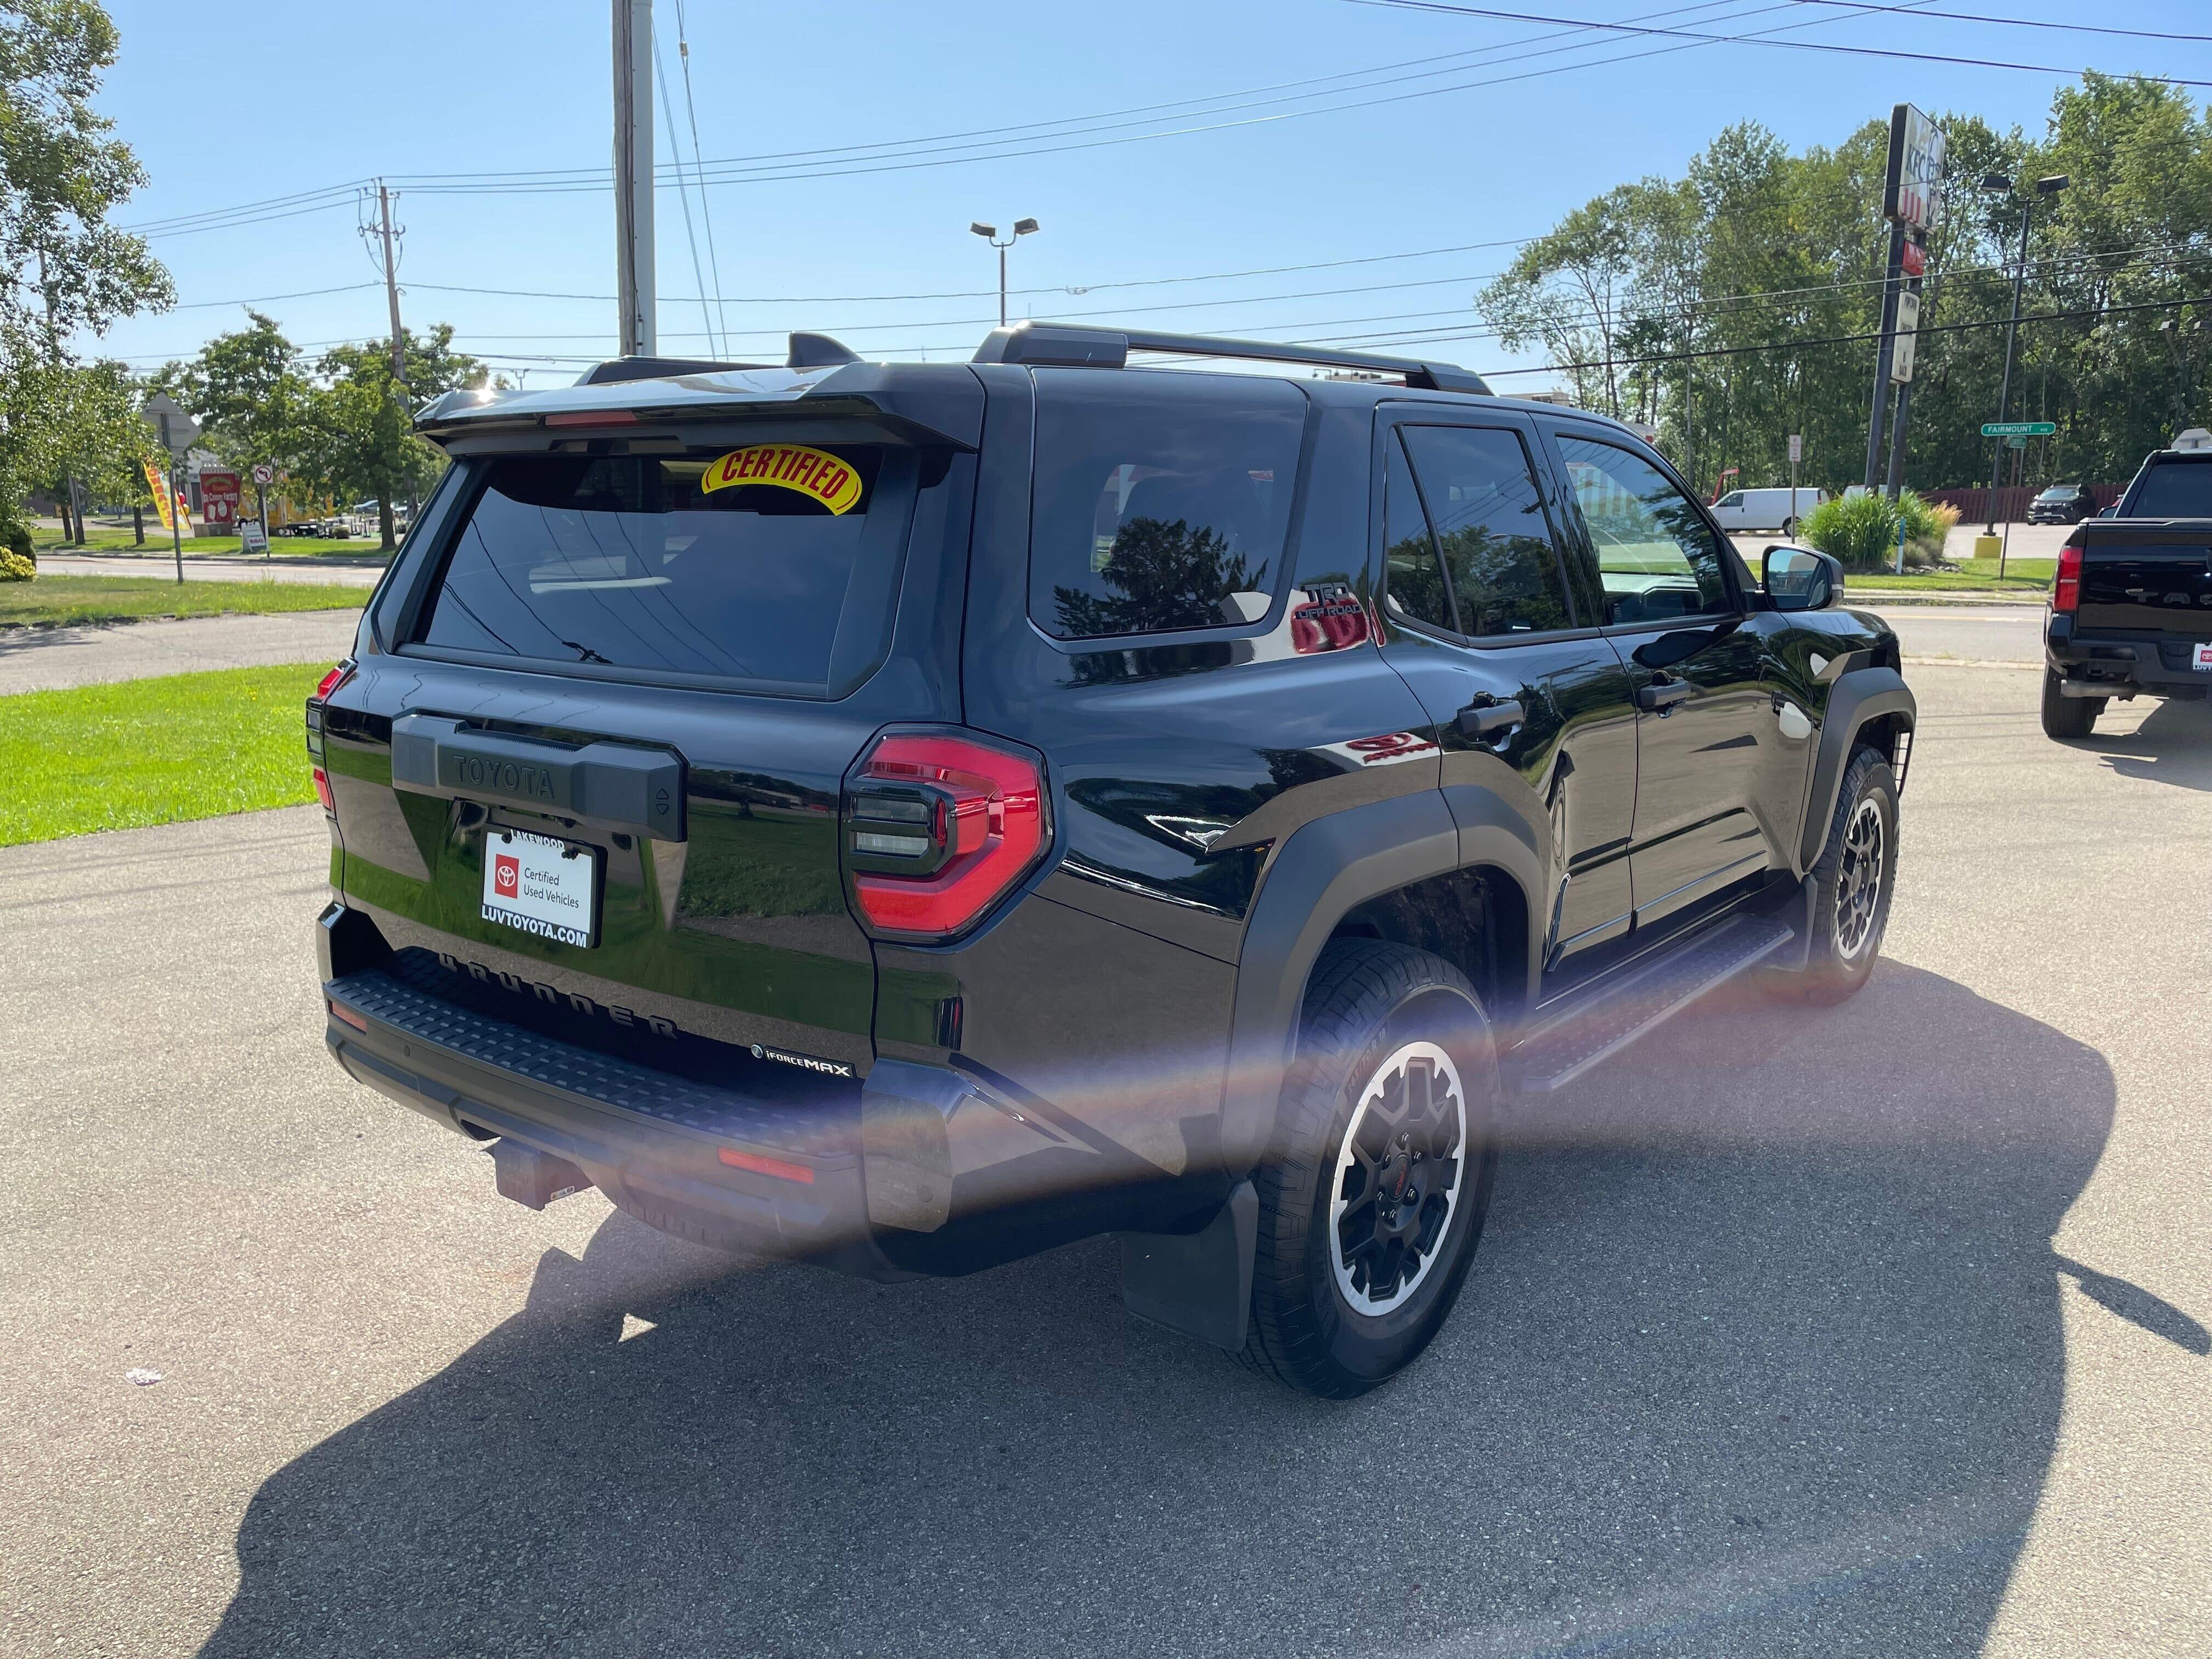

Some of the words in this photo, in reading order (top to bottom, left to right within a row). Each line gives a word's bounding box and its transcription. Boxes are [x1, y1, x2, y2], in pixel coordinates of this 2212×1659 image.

[1906, 143, 1926, 182] KFC
[721, 449, 849, 499] CERTIFIED
[1301, 582, 1348, 606] TRD
[1326, 604, 1362, 616] ROAD
[454, 755, 555, 798] TOYOTA
[510, 828, 565, 850] LAKEWOOD
[524, 867, 560, 886] Certified
[524, 884, 544, 900] Used
[546, 888, 579, 909] Vehicles
[481, 905, 587, 948] LUVTOYOTA.COM
[439, 953, 678, 1040] 4RUNNER
